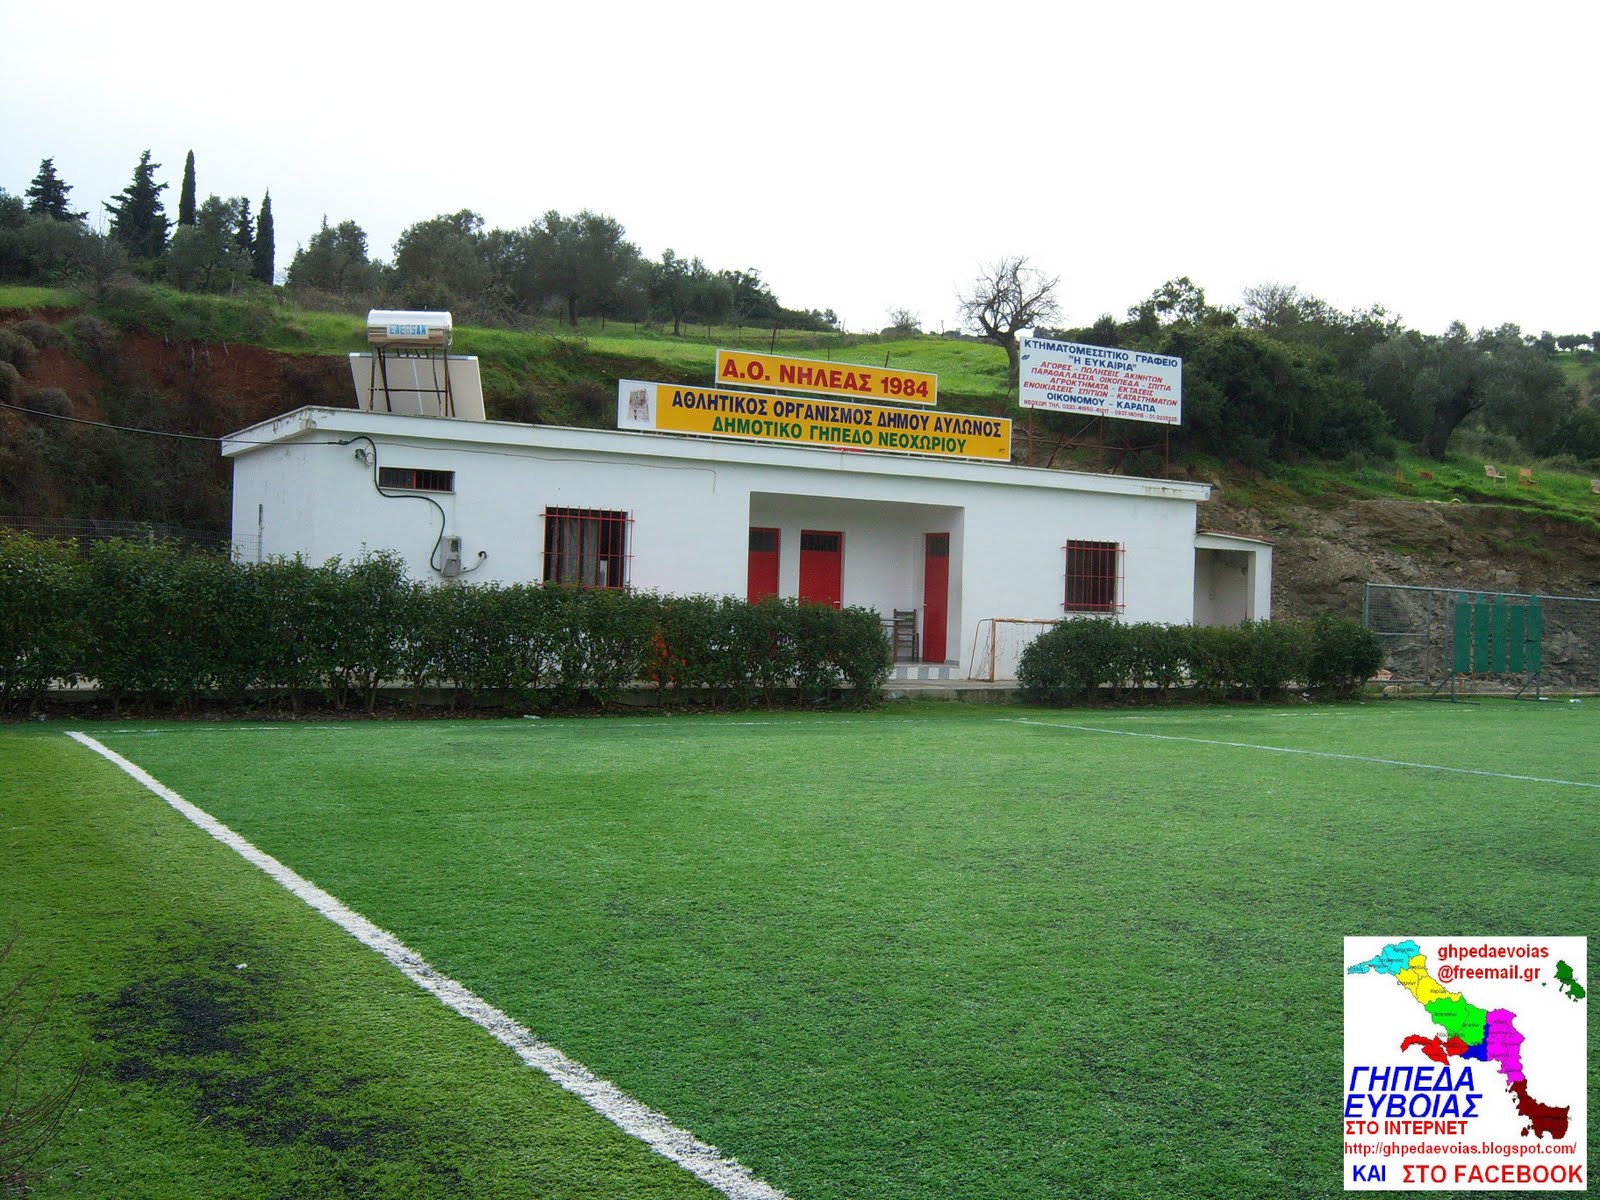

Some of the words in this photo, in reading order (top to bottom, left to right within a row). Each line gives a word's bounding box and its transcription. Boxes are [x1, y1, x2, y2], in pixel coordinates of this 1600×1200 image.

[1024, 339, 1129, 361] ΚΤΗΜΑΤΟΜΕΣΣΙΤΙΚΟ
[1135, 354, 1178, 368] ΓΡΑΦΕΙΟ
[722, 359, 771, 381] Α.Ο.
[779, 364, 872, 392] ΝΗΛΕΑΣ
[880, 376, 929, 397] 1984
[1040, 361, 1073, 371] ΑΓΟΡΕΣ
[1080, 366, 1120, 377] ΠΩΛΗΣΕΙΣ
[1124, 372, 1163, 383] ΑΚΙΝΗΤΩΝ
[1099, 376, 1139, 388] ΟΙΚΟΠΕΔΑ
[1147, 382, 1172, 392] ΣΠΙΤΙΑ
[1023, 381, 1074, 394] ΕΝΟΙΚΙΑΣΕΙΣ
[1077, 388, 1109, 398] ΣΠΙΤΙΩΝ
[1116, 393, 1178, 406] ΚΑΤΑΣΤΗΜΑΤΩΝ
[1049, 377, 1109, 391] ΑΓΡΟΚΤΗΜΑΤΑ
[1117, 385, 1154, 397] ΕΚΤΑΣΕΙΣ
[672, 390, 768, 416] ΑΘΛΗΤΙΚΟΣ
[773, 400, 873, 426] ΟΡΓΑΝΙΣΜΟΣ
[877, 411, 930, 431] ΔΗΜΟΥ
[934, 416, 1002, 438] ΑΥΛΩΝΟΣ
[1046, 392, 1105, 407] ΟΙΚΟΝΟΜΟΥ
[1116, 401, 1156, 413] ΚΑΡΑΠΑ
[712, 416, 803, 439] ΔΗΜΟΤΙΚΟ
[809, 425, 873, 446] ΓΗΠΕΔΟ
[878, 432, 967, 454] ΝΕΟΧΩΡΙΟΥ
